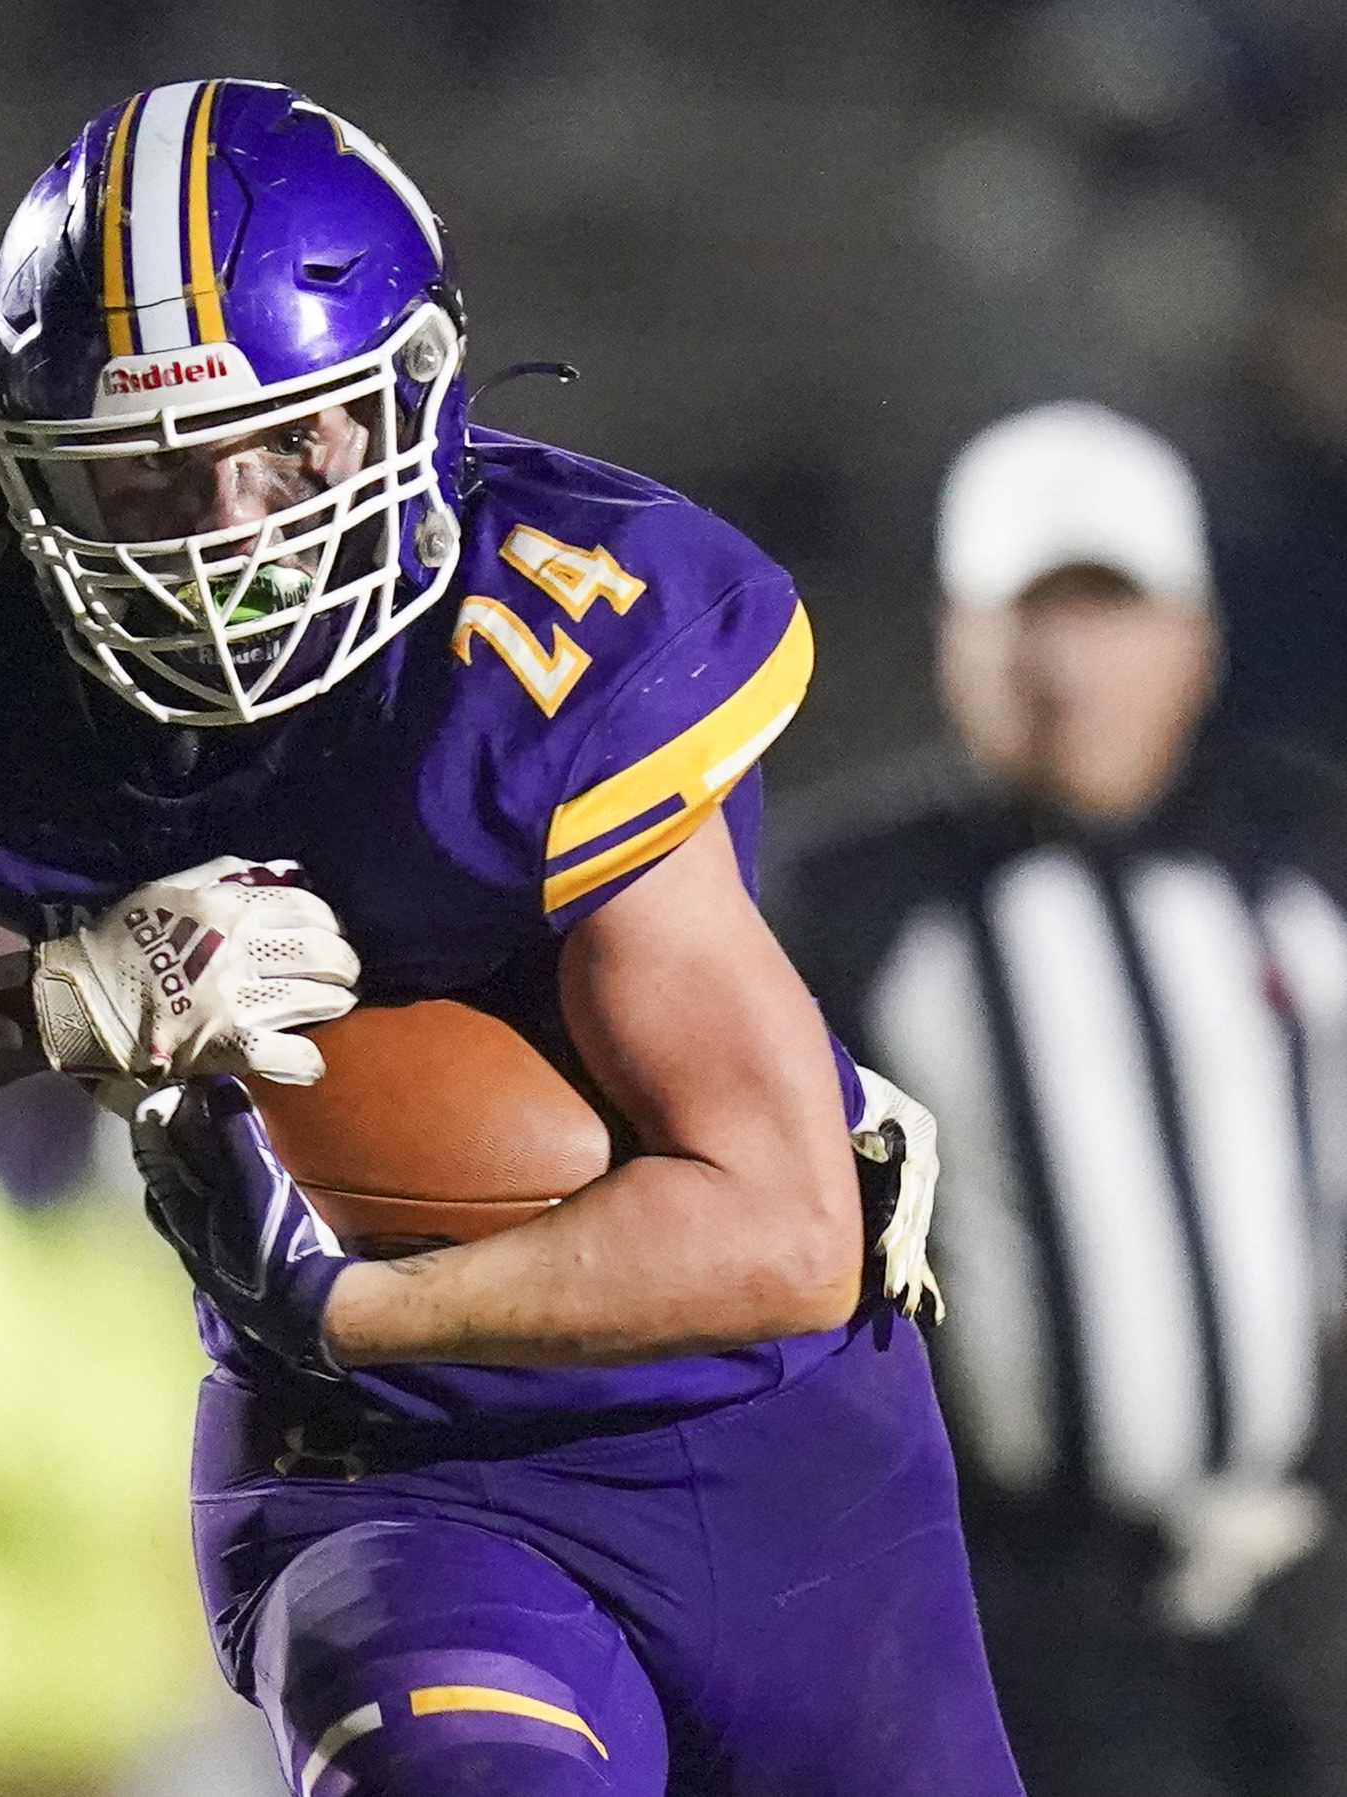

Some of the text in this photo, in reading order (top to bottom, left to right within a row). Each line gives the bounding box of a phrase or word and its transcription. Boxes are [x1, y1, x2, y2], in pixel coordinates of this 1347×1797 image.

[104, 352, 228, 396] Riddell
[451, 523, 648, 720] 24
[124, 907, 192, 1016] adidas
